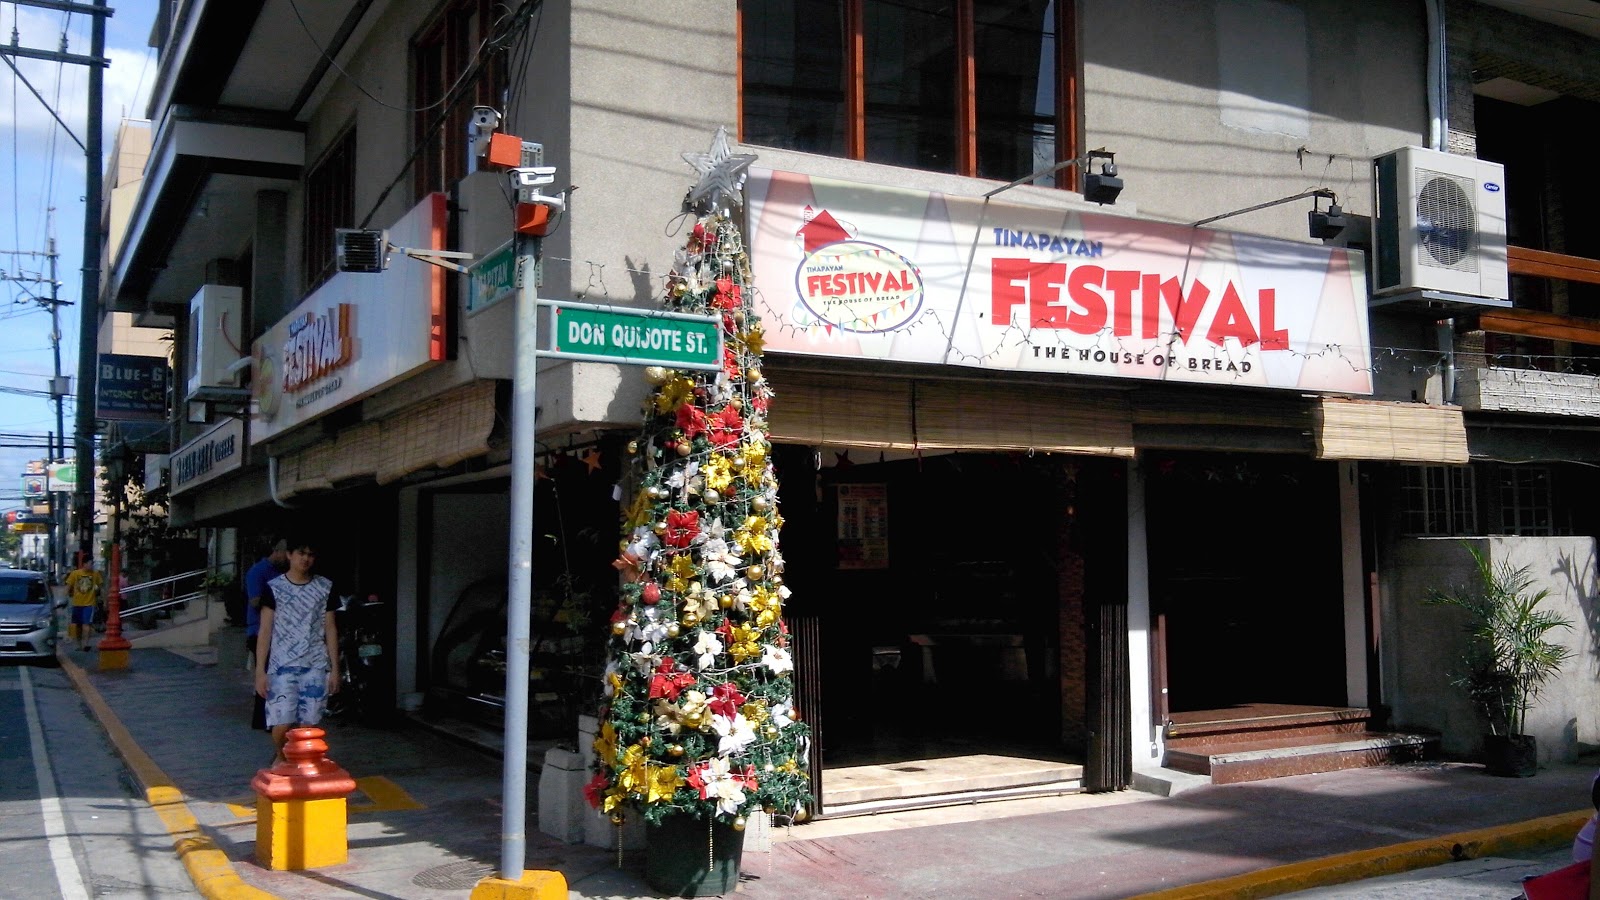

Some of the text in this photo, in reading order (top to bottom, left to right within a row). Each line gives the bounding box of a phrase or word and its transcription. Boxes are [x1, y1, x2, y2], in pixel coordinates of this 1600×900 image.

[993, 228, 1103, 258] TINAPAYAN
[806, 265, 844, 274] TINAPAYAN
[807, 270, 914, 297] FESTIVAL
[838, 298, 862, 306] HOUSE
[991, 257, 1290, 351] FESTIVAL
[568, 321, 708, 354] DON QUIJOTE ST.
[1032, 345, 1252, 374] THE HOUSE OF BREAD
